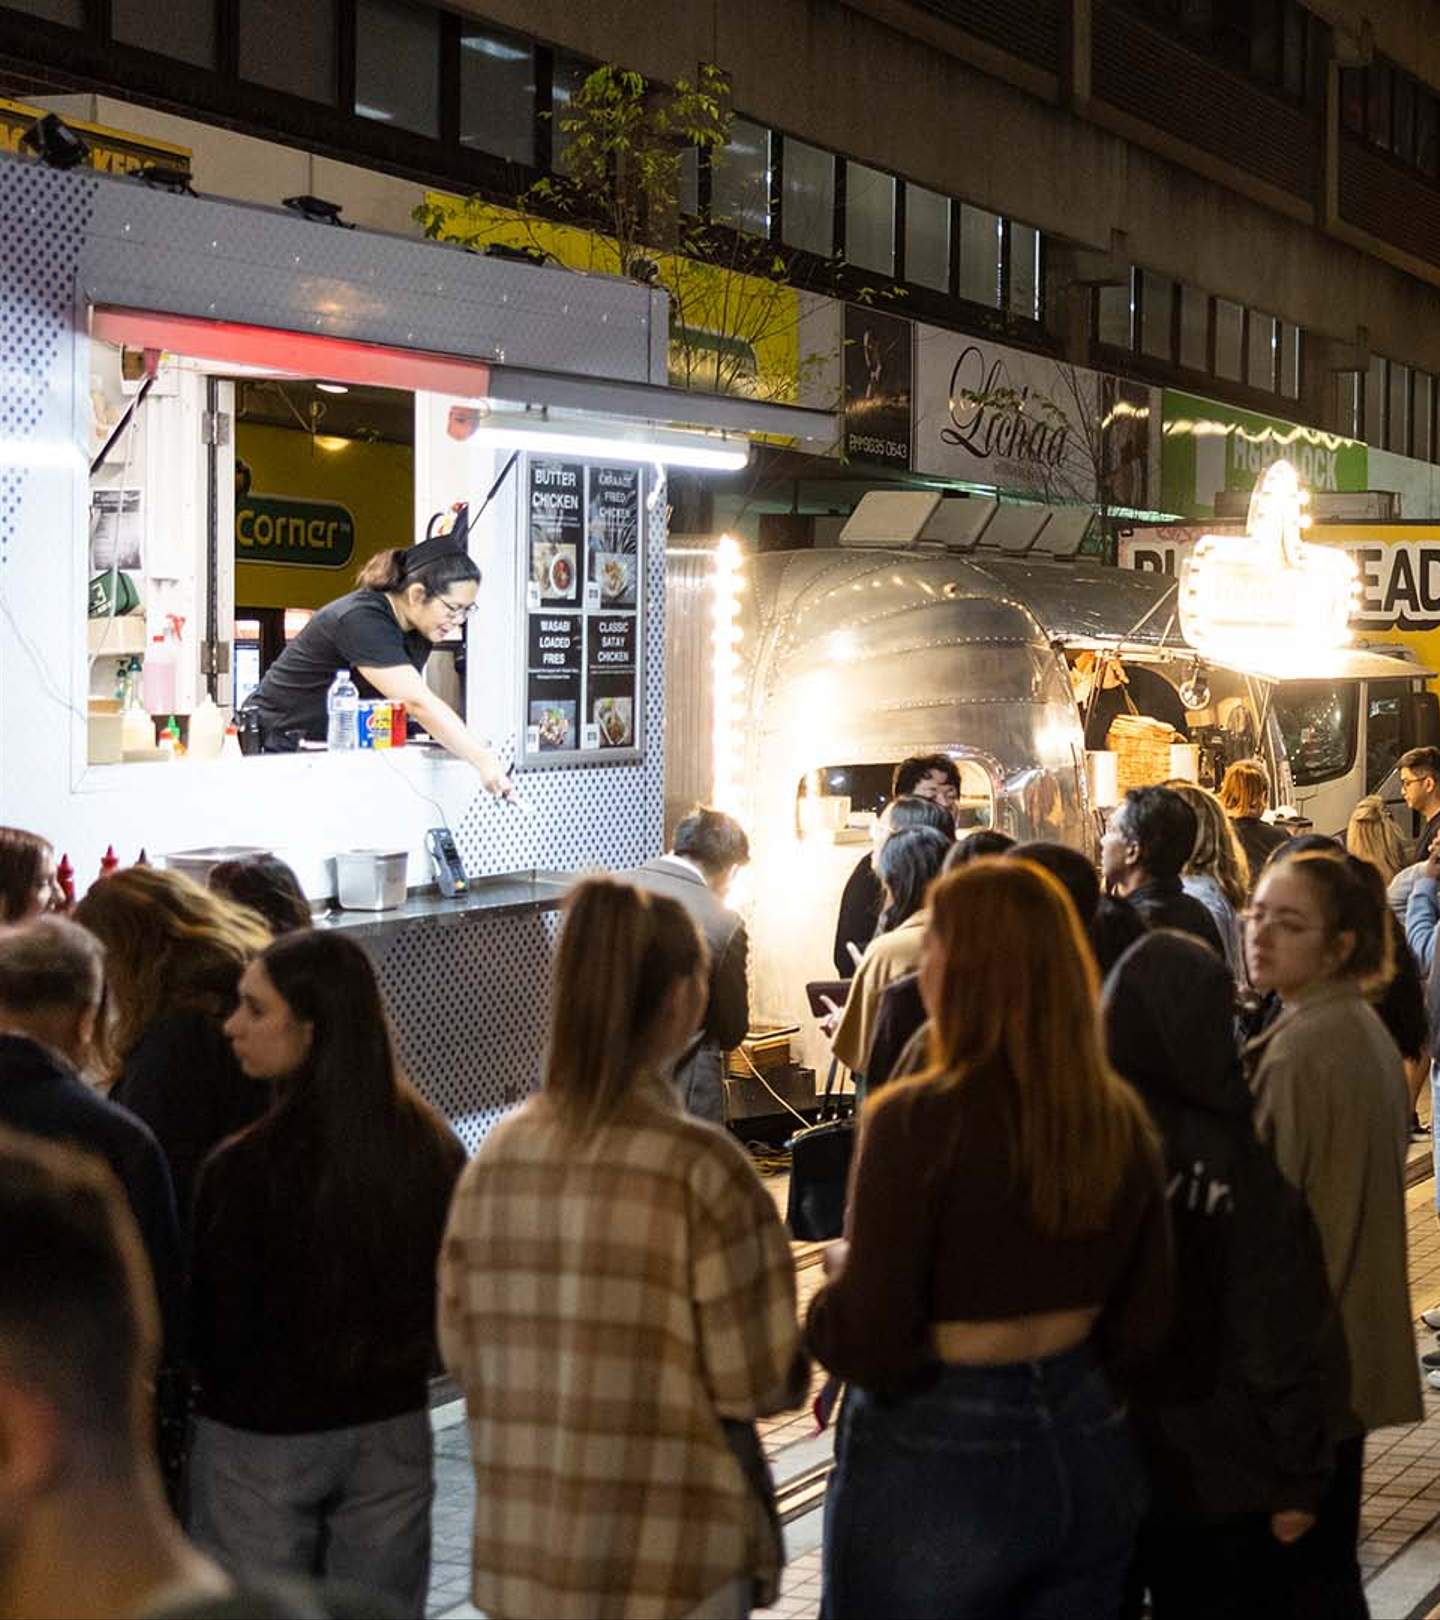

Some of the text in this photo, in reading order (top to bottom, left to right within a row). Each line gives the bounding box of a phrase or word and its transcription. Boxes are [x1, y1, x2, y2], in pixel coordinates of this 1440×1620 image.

[535, 469, 577, 487] BUTTER
[532, 492, 579, 510] CHICKEN
[604, 491, 626, 503] FRIED
[540, 620, 571, 632] WASABI
[599, 622, 629, 633] CLASSIC
[539, 636, 571, 648] LOADED
[602, 636, 625, 648] SATAY
[597, 651, 629, 662] CHICKEN
